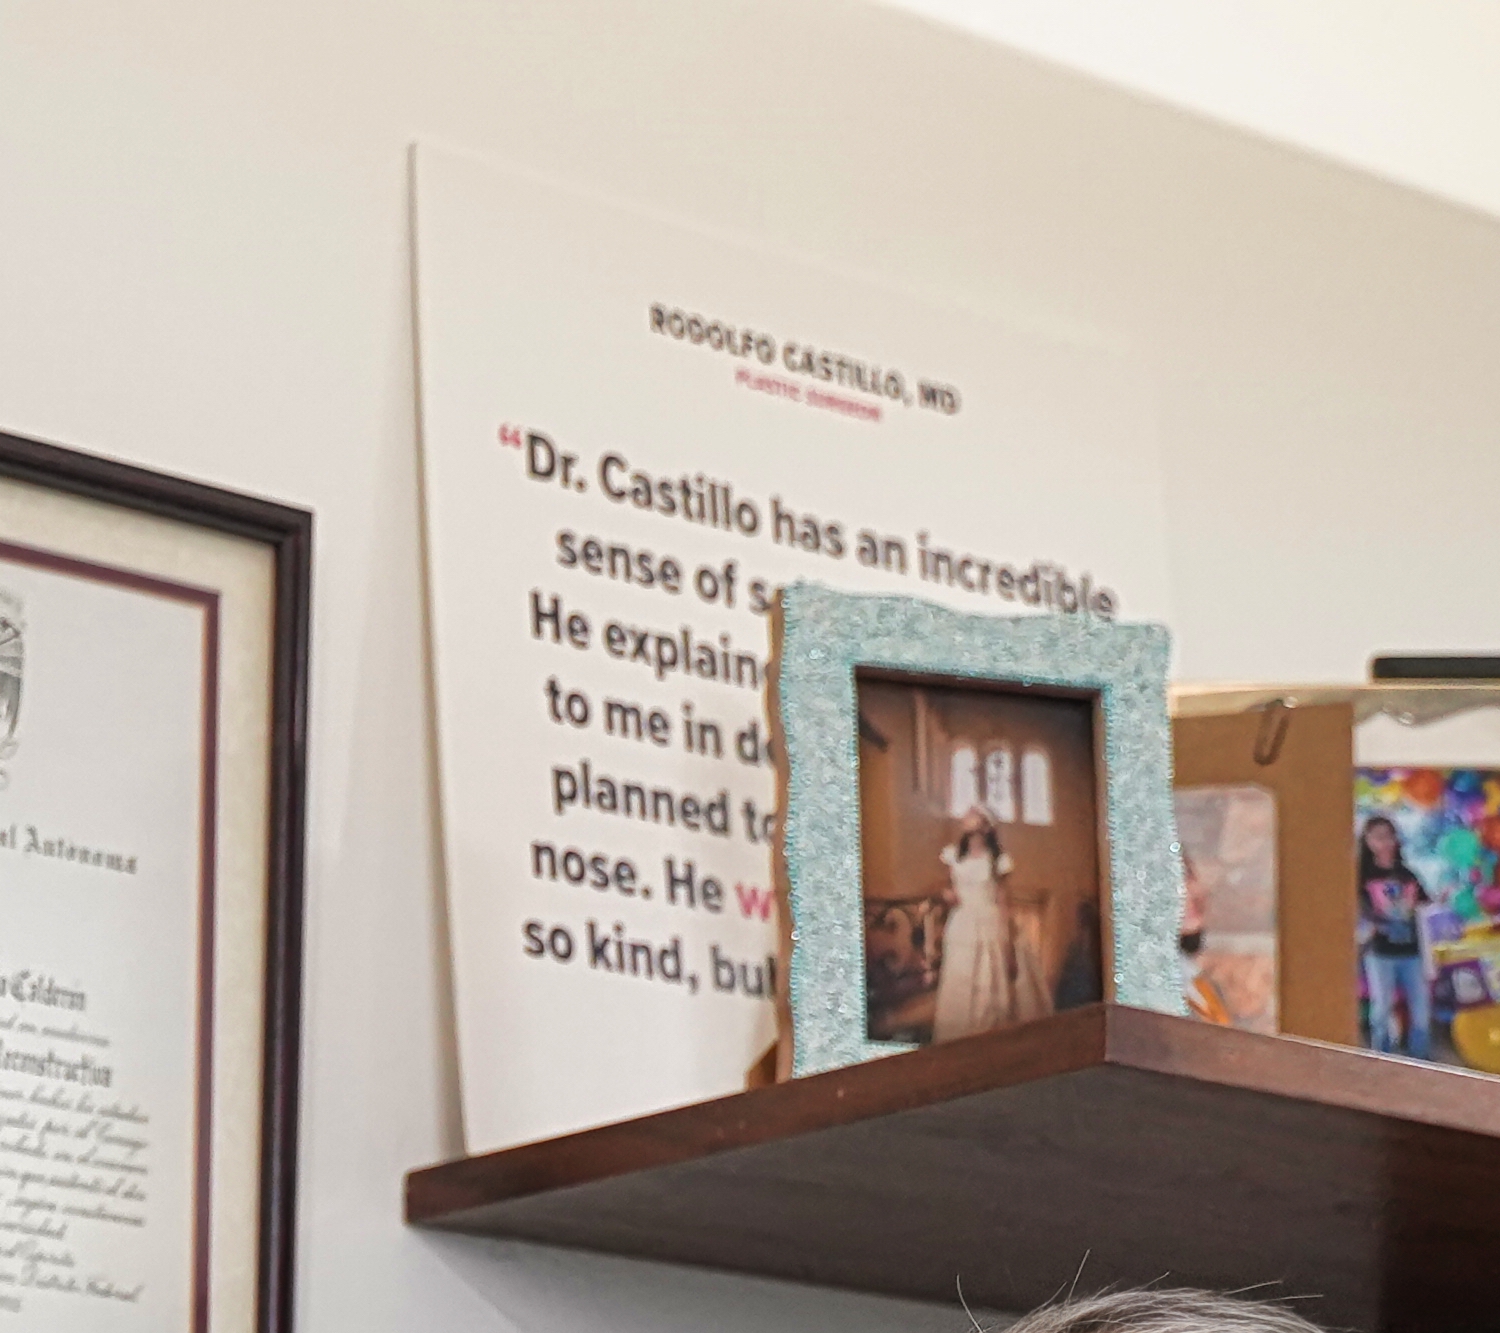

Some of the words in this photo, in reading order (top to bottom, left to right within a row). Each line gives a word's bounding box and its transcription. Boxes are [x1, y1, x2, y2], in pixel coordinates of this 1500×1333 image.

[649, 302, 777, 366] RODOLFO
[783, 343, 914, 408] CASTILLO,
[556, 530, 682, 595] sense
[695, 560, 736, 607] of
[598, 450, 760, 537] Castillo
[770, 493, 848, 560] has
[857, 530, 908, 575] an
[916, 529, 1117, 622] incredible
[530, 589, 589, 649] He
[604, 622, 760, 690] explain
[546, 675, 590, 727] to
[604, 696, 670, 746] me
[681, 700, 722, 759] in
[552, 757, 730, 836] planned
[531, 840, 652, 897] nose.
[664, 856, 722, 912] He
[524, 919, 574, 960] so
[586, 917, 699, 994] kind,
